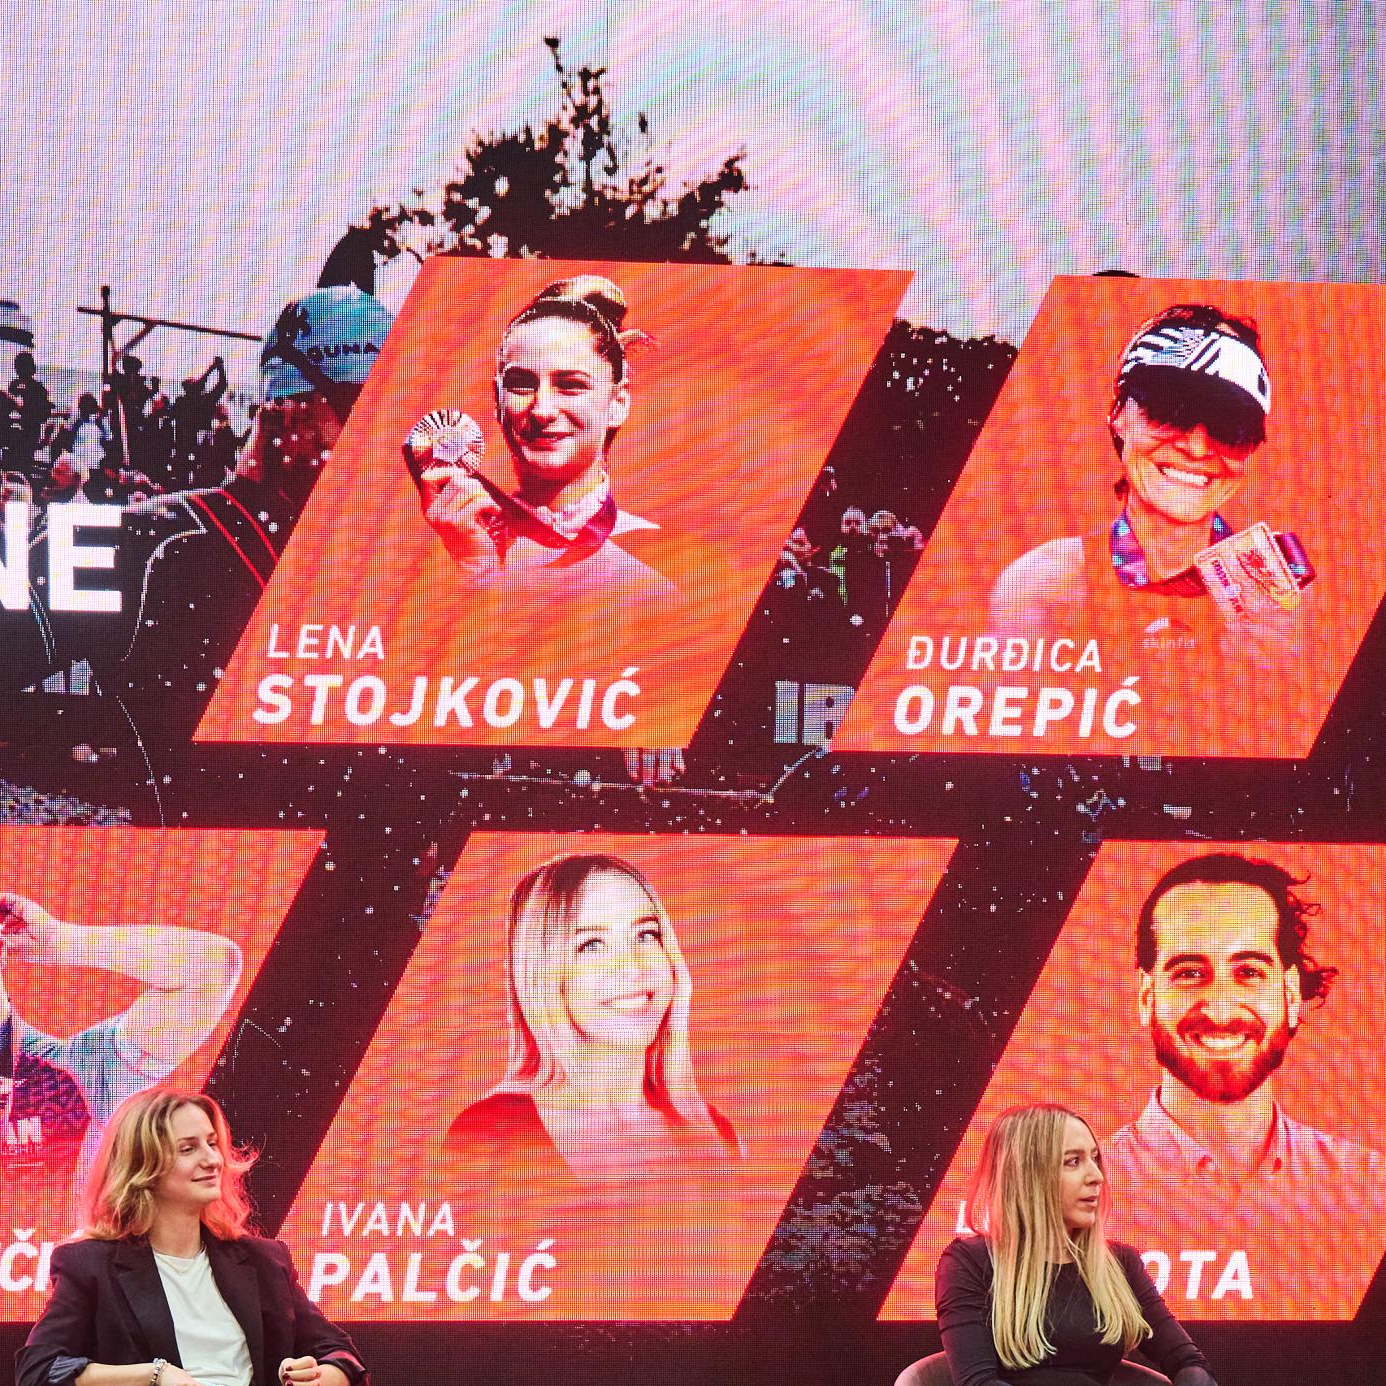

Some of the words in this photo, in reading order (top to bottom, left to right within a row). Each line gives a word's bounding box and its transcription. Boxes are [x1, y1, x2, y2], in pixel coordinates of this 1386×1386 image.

[266, 623, 387, 660] LENA
[906, 635, 1104, 674] ĐURĐICA
[252, 667, 644, 731] STOJKOVIĆ
[893, 675, 1142, 739] OREPIĆ
[320, 1201, 457, 1238] IVANA
[308, 1240, 558, 1304] PALČIĆ
